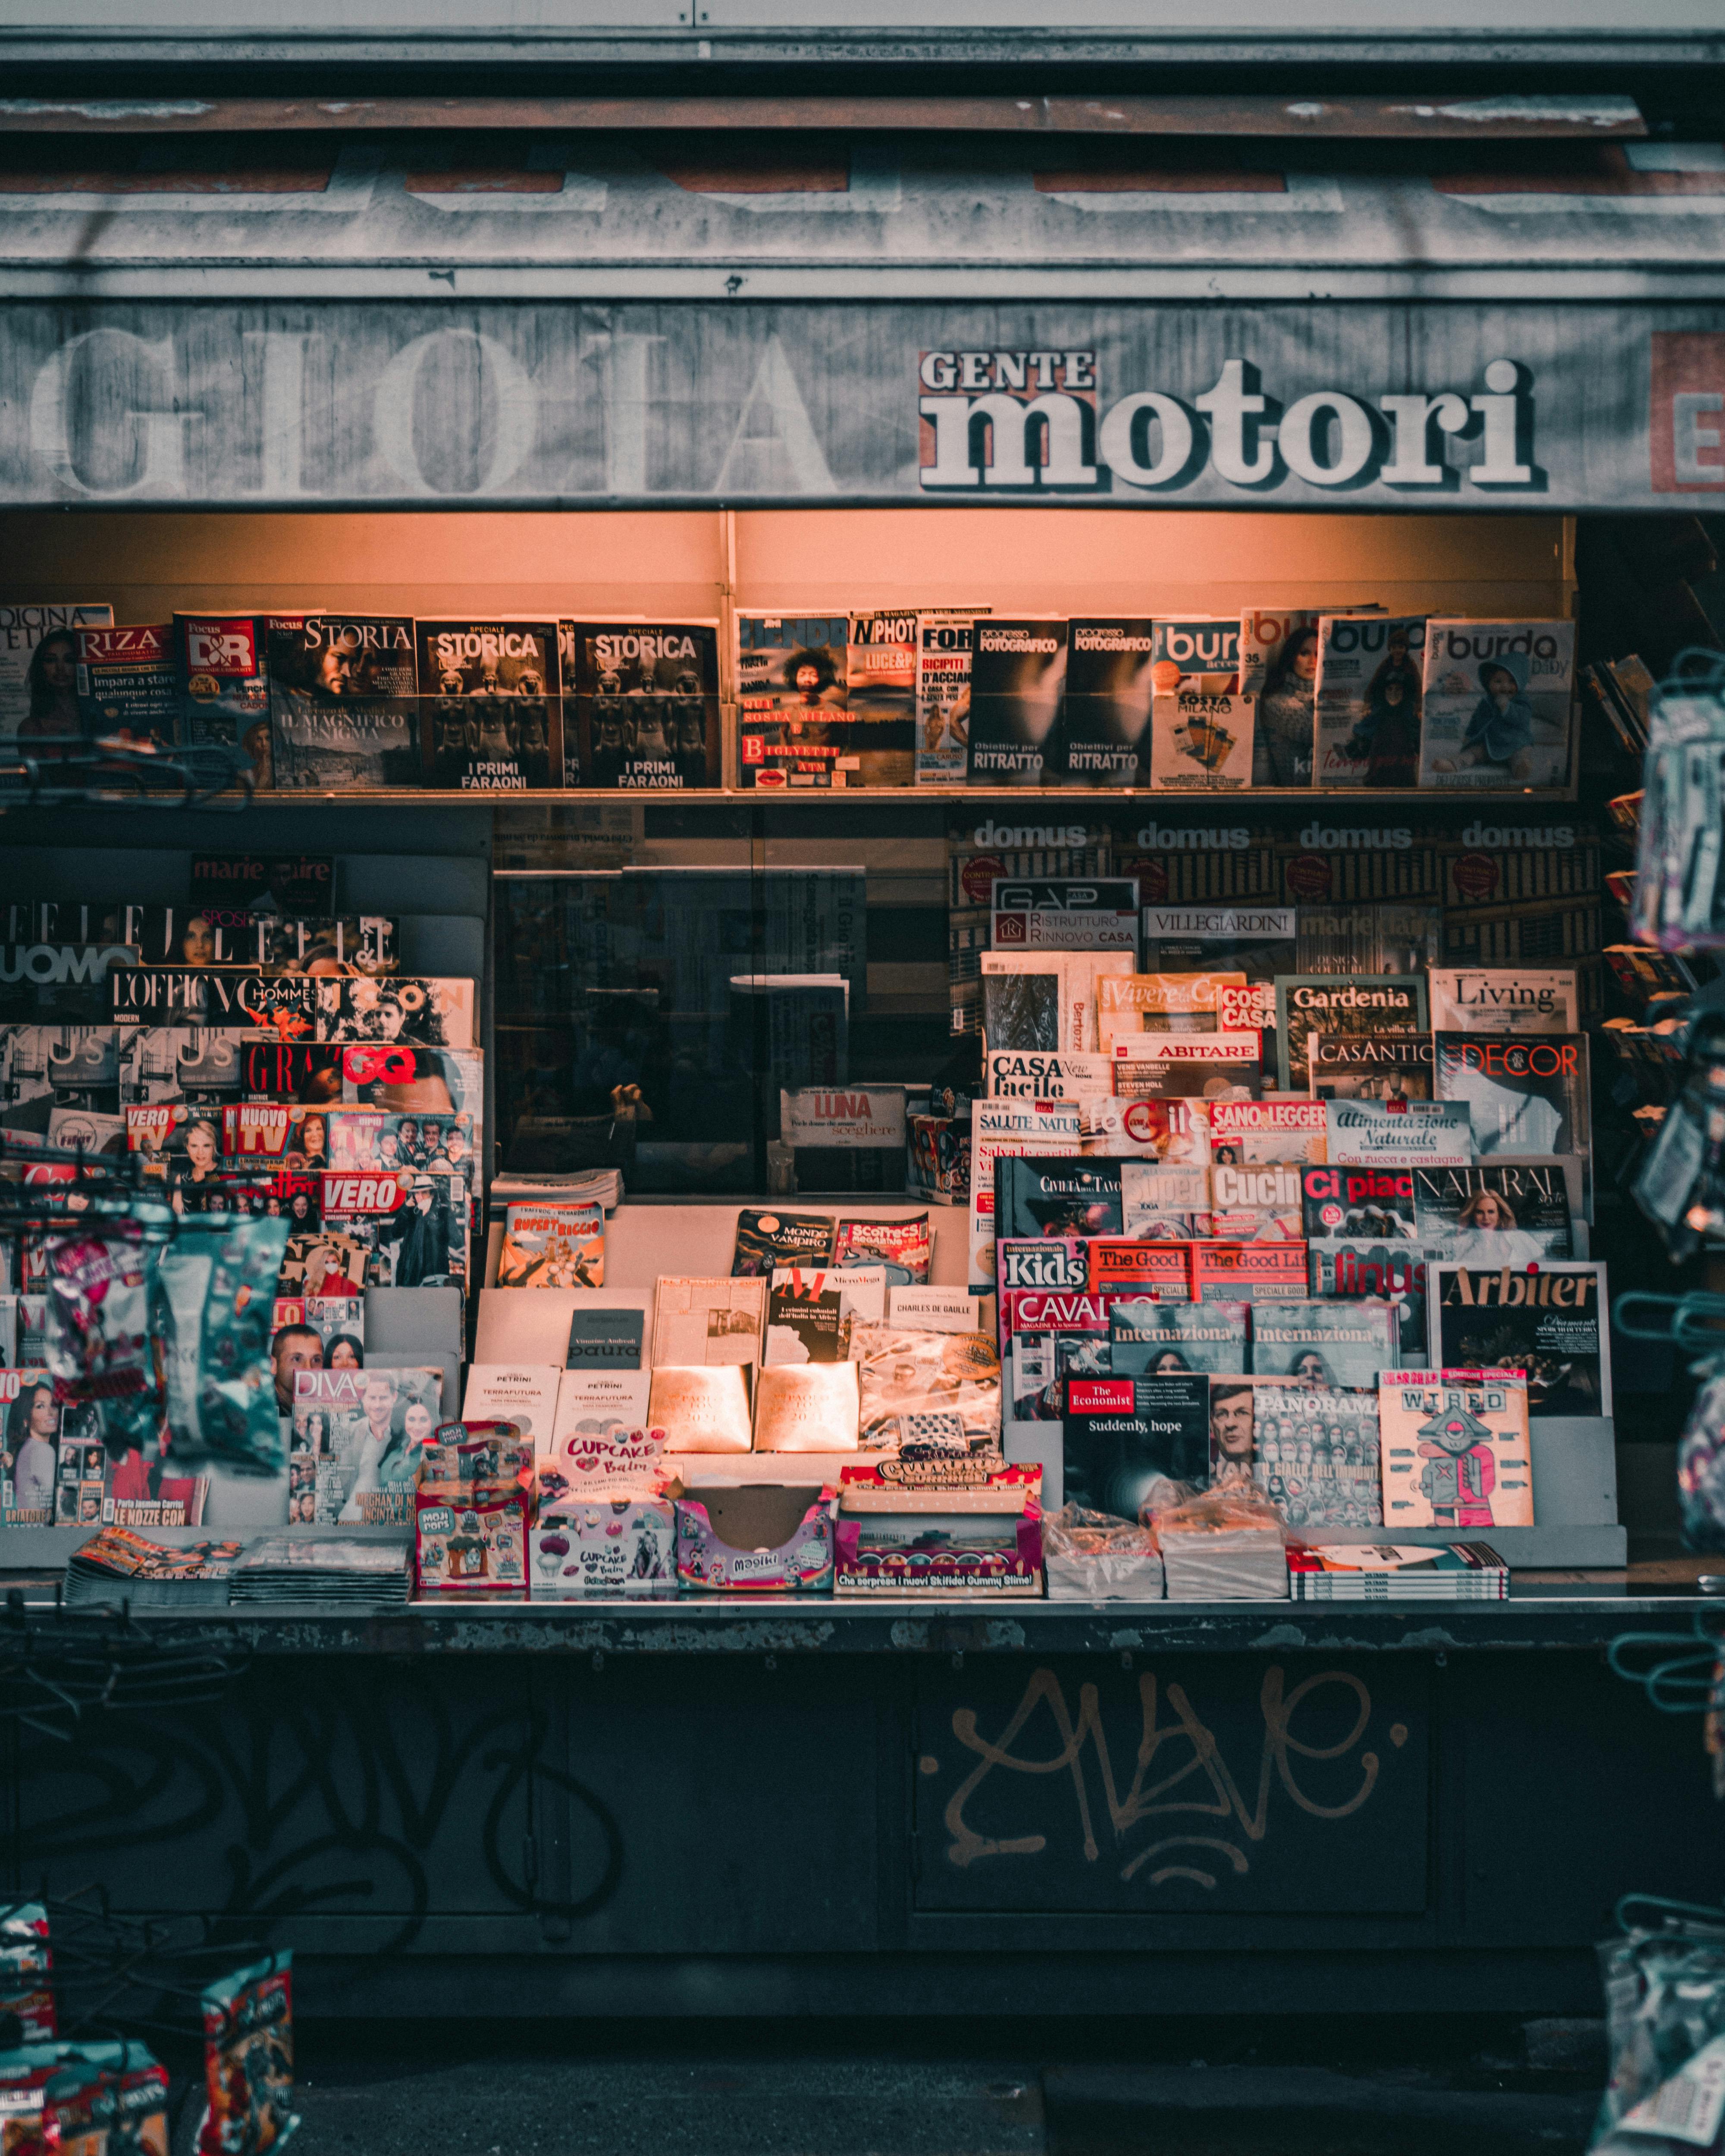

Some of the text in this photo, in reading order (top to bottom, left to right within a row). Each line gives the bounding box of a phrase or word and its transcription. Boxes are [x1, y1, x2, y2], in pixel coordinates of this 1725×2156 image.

[919, 351, 1096, 392] GENTE
[30, 326, 841, 496] GIOIA
[920, 359, 1540, 487] motori
[188, 624, 220, 635] Focus
[269, 619, 302, 630] Focus
[304, 617, 414, 650] STORIA
[79, 630, 162, 659] RIZA
[189, 634, 253, 667] D&R
[438, 633, 539, 658] STORICA
[596, 635, 696, 659] STORICA
[980, 639, 1057, 653] FOTOGRAFICO
[1075, 637, 1152, 652] FOTOGRAFICO
[1447, 629, 1558, 660] burda
[922, 659, 963, 670] BICIPITI
[1245, 653, 1260, 663] 35
[1531, 656, 1571, 678] baby
[94, 677, 134, 690] Impara
[95, 689, 147, 701] qualunque
[1178, 696, 1232, 706] SOSTA
[743, 712, 856, 722] SOSTA MILANO
[1178, 705, 1232, 715] MILANO
[281, 714, 405, 728] IL MAGNIFICO
[307, 727, 379, 740] ENIGMA
[975, 742, 1038, 752] Obiettivi per
[1070, 742, 1133, 752] Obiettivi per
[477, 762, 518, 775] PRIMI
[634, 761, 675, 774] PRIMI
[799, 763, 826, 772] ATM
[974, 753, 1044, 770] RITRATTO
[1069, 753, 1138, 770] RITRATTO
[462, 777, 526, 789] FARAONI
[618, 775, 684, 789] FARAONI
[974, 820, 1087, 849] domus
[1137, 821, 1250, 850] domus
[1300, 821, 1412, 850] domus
[1462, 820, 1575, 849] domus
[194, 856, 264, 880] marie
[1030, 912, 1120, 928] RISTRUTTURO
[1156, 913, 1289, 934] VILLEGIARDINI
[1300, 910, 1373, 936] marie
[1030, 927, 1134, 944] RINNOVO CASA
[332, 982, 464, 1011] ICON
[1223, 988, 1276, 1010] COSE
[1294, 986, 1409, 1008] Gardenia
[1456, 978, 1556, 1013] Living
[114, 1013, 140, 1023] MODERN
[1223, 1009, 1276, 1029] CASA
[1073, 1003, 1085, 1051] Bertozzi
[1385, 1025, 1406, 1034] villa
[1157, 1046, 1254, 1057] ABITARE
[1462, 1044, 1579, 1076] DECOR
[342, 1046, 417, 1085] GQ
[993, 1056, 1063, 1078] CASA
[994, 1076, 1063, 1098] facile
[815, 1094, 872, 1119] LUNA
[127, 1110, 169, 1127] VERO
[241, 1108, 287, 1127] NUOVO
[980, 1114, 1081, 1131] SALUTE NATUR
[1213, 1106, 1326, 1128] SANO LEGGER
[1337, 1111, 1458, 1130] Alimentazione
[128, 1125, 168, 1152] TV
[239, 1125, 287, 1152] TV
[832, 1122, 896, 1138] scegliere
[1360, 1129, 1437, 1146] Naturale
[979, 1145, 1017, 1157] Salva
[1337, 1153, 1361, 1165] Con
[1364, 1154, 1397, 1165] zucca
[1410, 1154, 1464, 1166] castagne
[1040, 1175, 1081, 1193] CIVILTÀ
[1215, 1166, 1301, 1206] Cucin
[1304, 1169, 1412, 1203] Ci piac
[1417, 1167, 1552, 1198] NATURAL
[324, 1179, 397, 1209] VERO
[514, 1218, 600, 1237] RUPERT RICCIO
[784, 1226, 828, 1239] MONDO
[771, 1233, 827, 1248] VAMPIRO
[1006, 1244, 1064, 1253] Internazionale
[1099, 1251, 1179, 1267] The Good
[1201, 1252, 1280, 1268] The Good
[1005, 1253, 1085, 1287] Kids
[1335, 1252, 1425, 1294] linus
[834, 1275, 880, 1285] MicroMega
[1442, 1263, 1597, 1308] Arbiter
[1153, 1285, 1186, 1294] SPECIALE
[1254, 1285, 1305, 1295] SPECIALE GOOD
[897, 1304, 971, 1314] CHARLES DE GAULLE
[568, 1345, 640, 1360] paura
[1447, 1369, 1518, 1380] EDIZIONE SPECIALE
[295, 1370, 357, 1397] DIVA
[1092, 1386, 1111, 1396] The
[1073, 1395, 1131, 1406] Economist
[1257, 1395, 1378, 1414] PANORAM
[1403, 1390, 1505, 1411] WIRED
[440, 1426, 464, 1437] MOJI
[1089, 1420, 1182, 1433] Suddenly, hope
[567, 1437, 656, 1458] CUPCAKE
[603, 1460, 648, 1474] Balm
[1273, 1463, 1308, 1478] GIALLO
[135, 1499, 184, 1509] Jasmine Carrisi
[355, 1492, 392, 1507] MEGHAN
[114, 1509, 185, 1526] LE NOZZE CON
[362, 1507, 395, 1521] INCINTA
[422, 1510, 449, 1523] MOJI
[580, 1551, 627, 1565] CUPCAKE
[734, 1555, 779, 1573] Magiki
[838, 1576, 1033, 1589] Che sorpresa nuovi Skifidol Gummy Slime!
